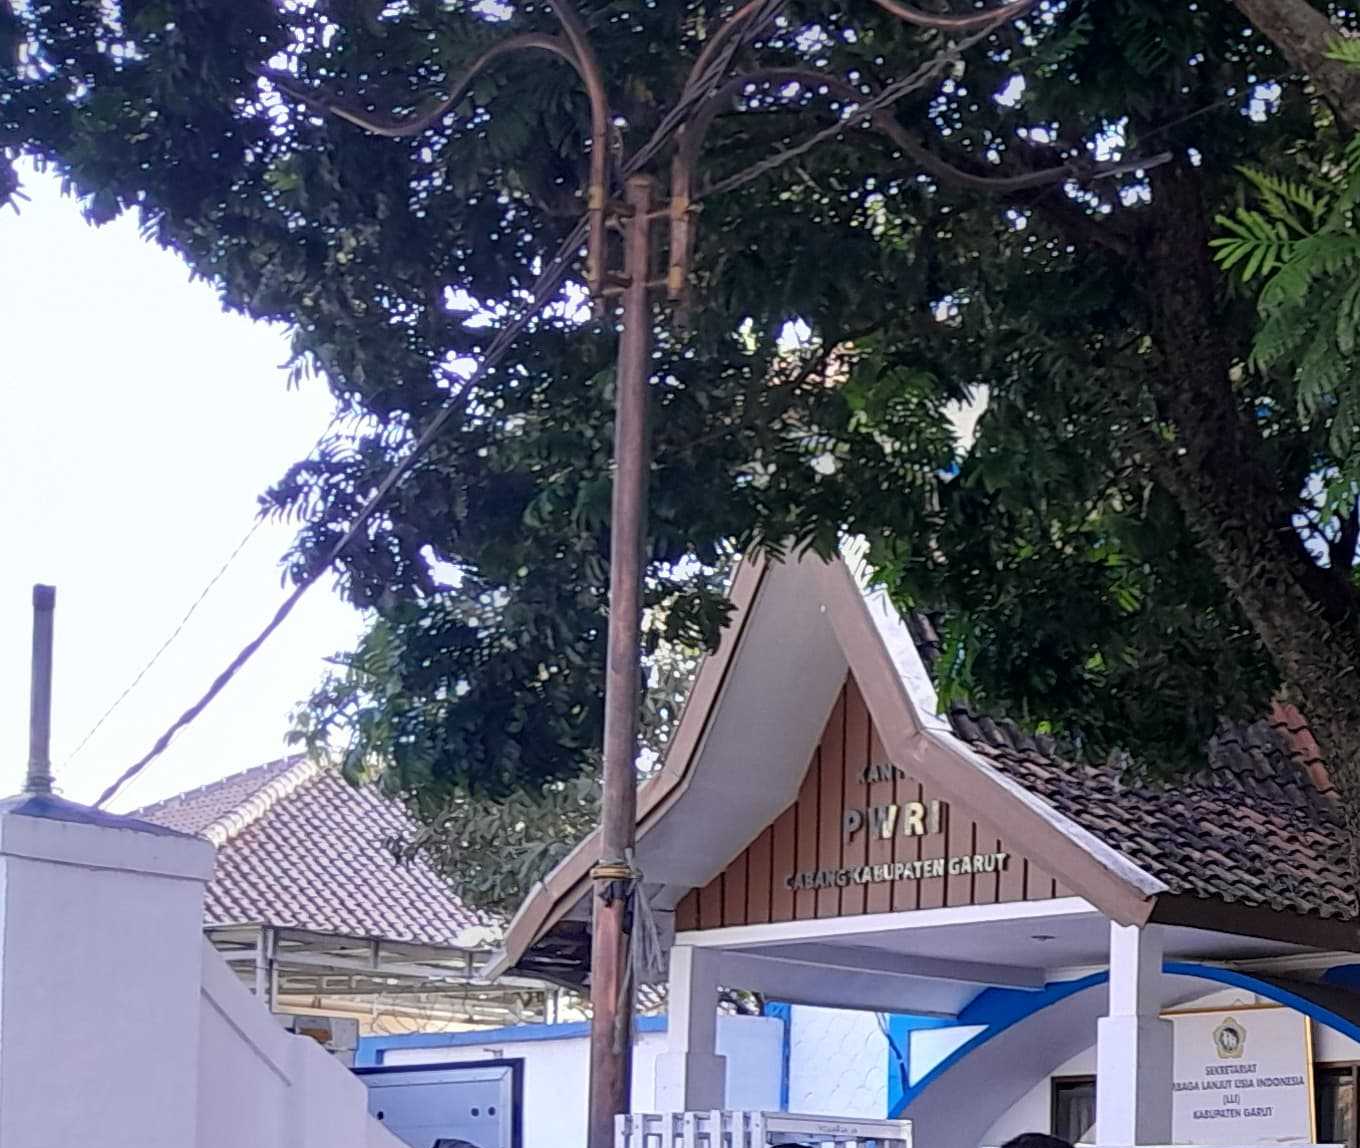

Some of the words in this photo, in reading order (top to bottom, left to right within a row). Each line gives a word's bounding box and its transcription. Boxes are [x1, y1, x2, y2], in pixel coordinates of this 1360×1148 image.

[845, 800, 943, 842] PWRI
[784, 869, 848, 890] CABANG
[851, 857, 945, 885] KABUPATEN
[948, 852, 1009, 875] GARUT
